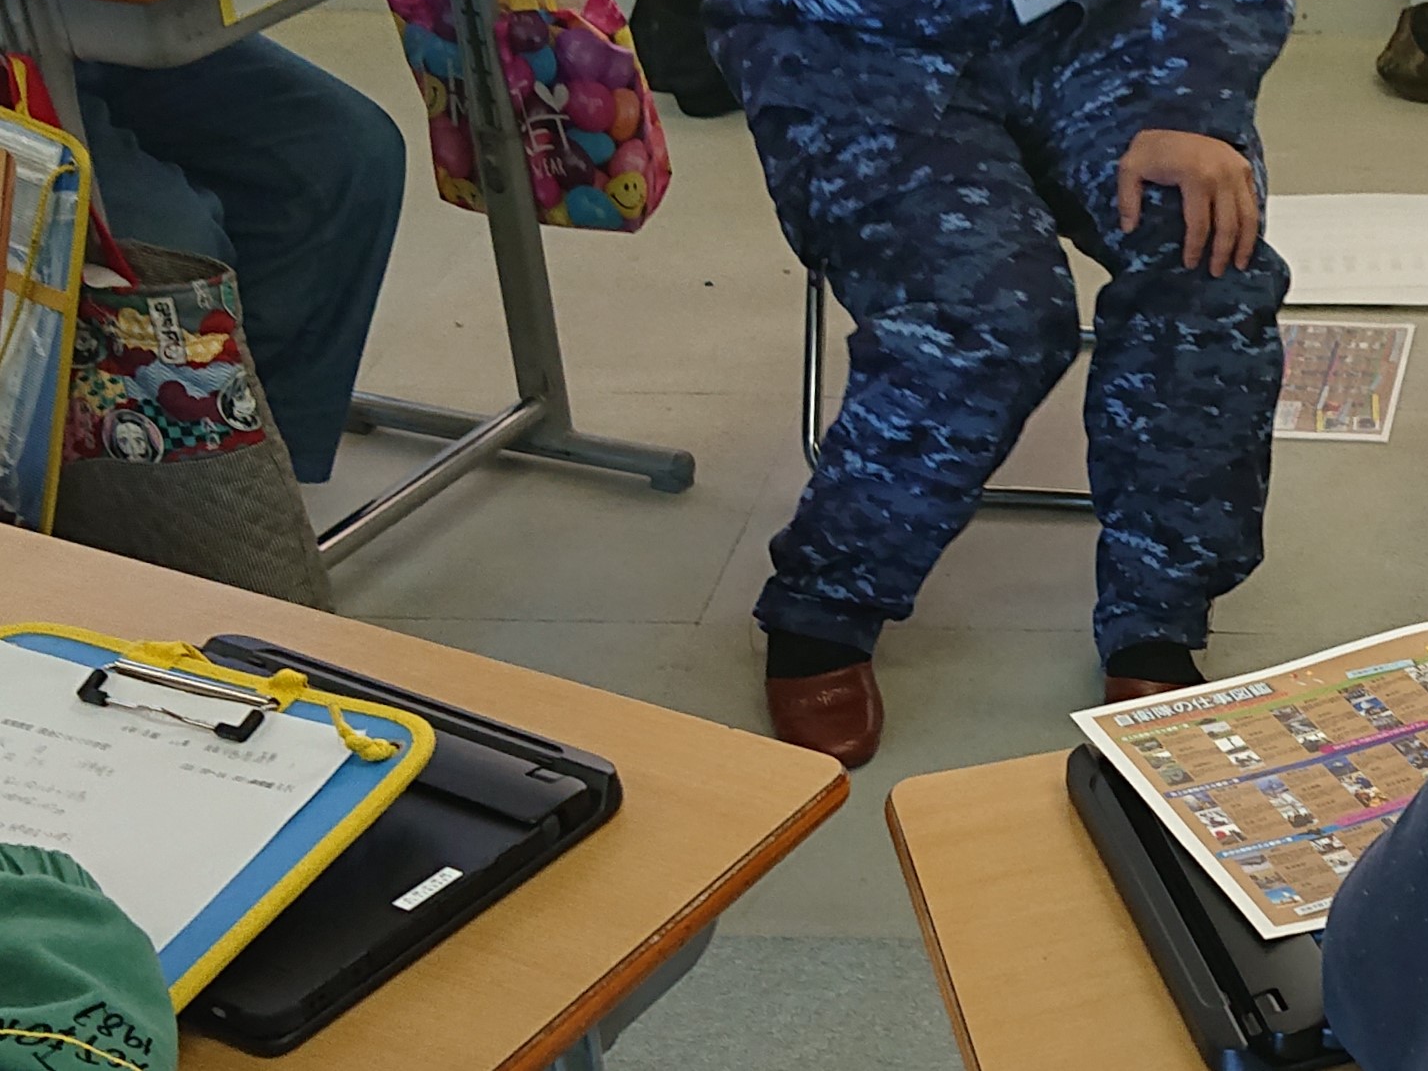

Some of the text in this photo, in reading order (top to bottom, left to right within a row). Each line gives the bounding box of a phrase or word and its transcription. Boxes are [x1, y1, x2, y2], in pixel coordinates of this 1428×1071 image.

[1113, 682, 1275, 728] 自衛隊の仕事図鑑
